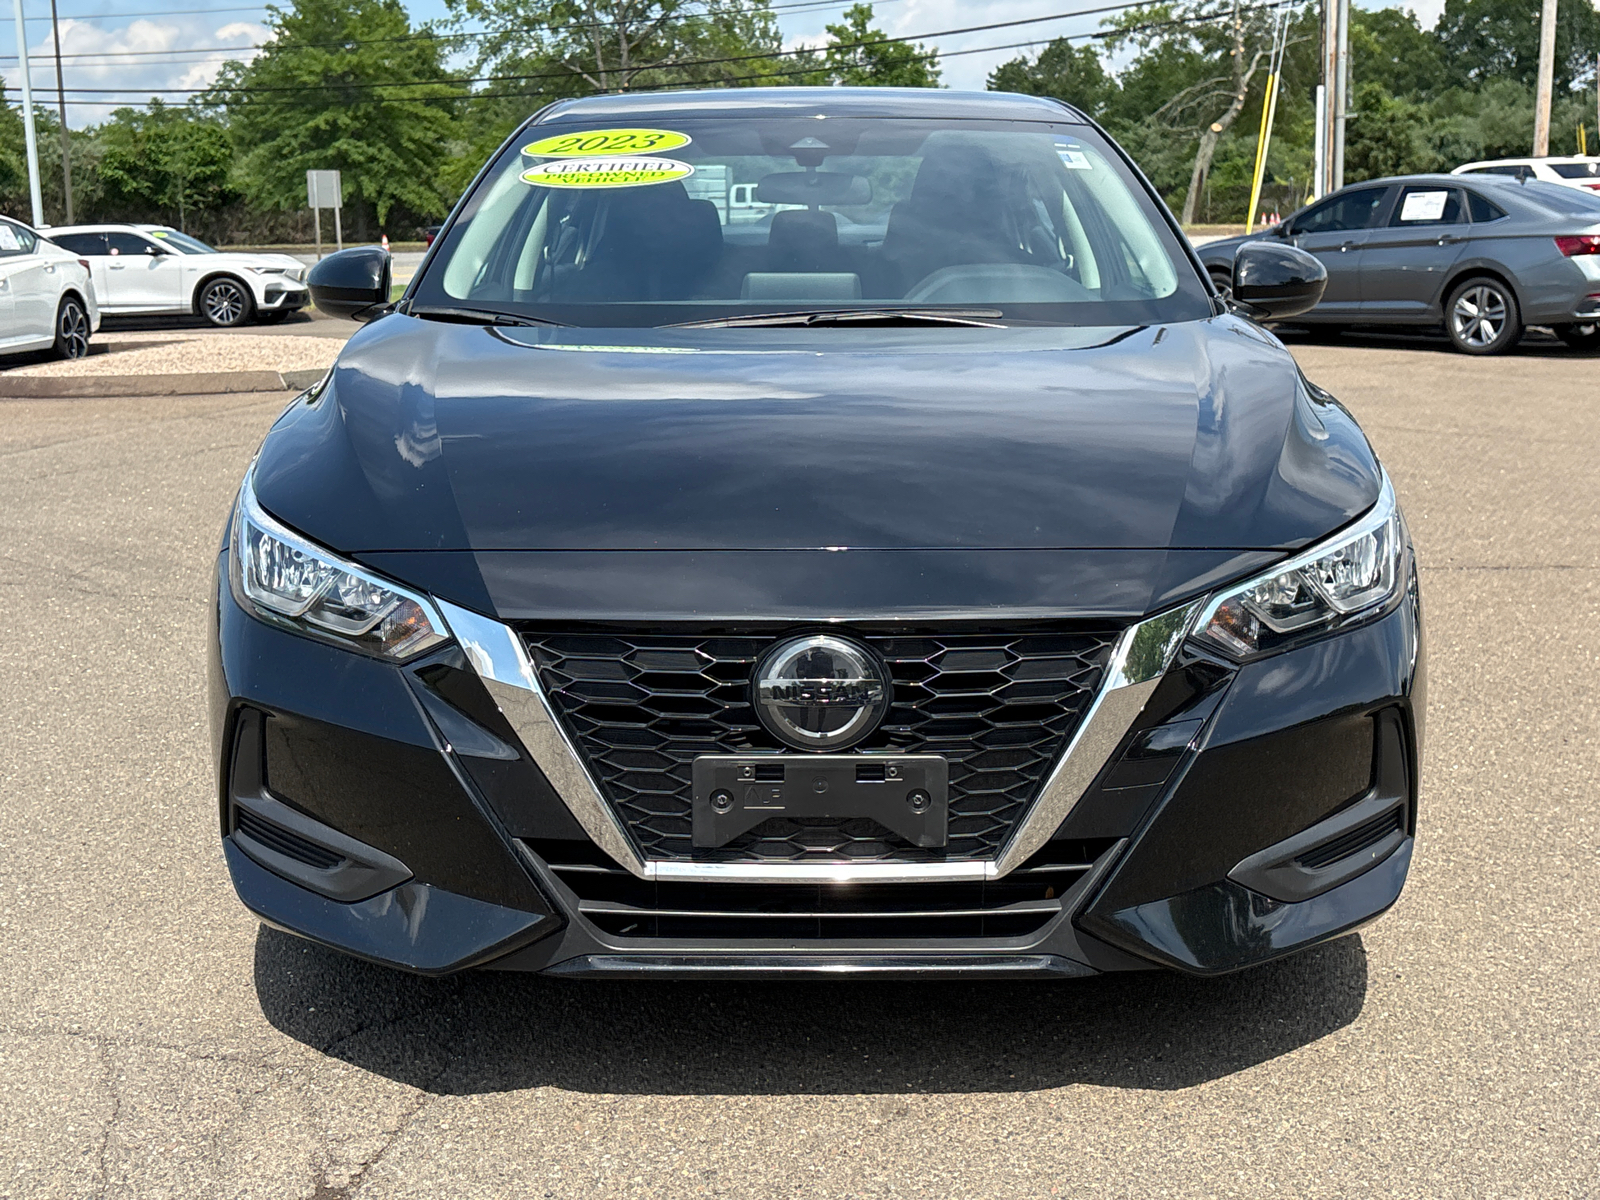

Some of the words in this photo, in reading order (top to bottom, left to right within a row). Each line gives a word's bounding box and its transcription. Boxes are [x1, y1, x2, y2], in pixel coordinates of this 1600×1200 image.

[547, 134, 666, 153] 2023
[543, 162, 676, 174] CERTIFIED
[545, 171, 666, 180] PRE-OWNED
[561, 176, 646, 184] VEHICLE
[772, 685, 869, 701] NISSAN
